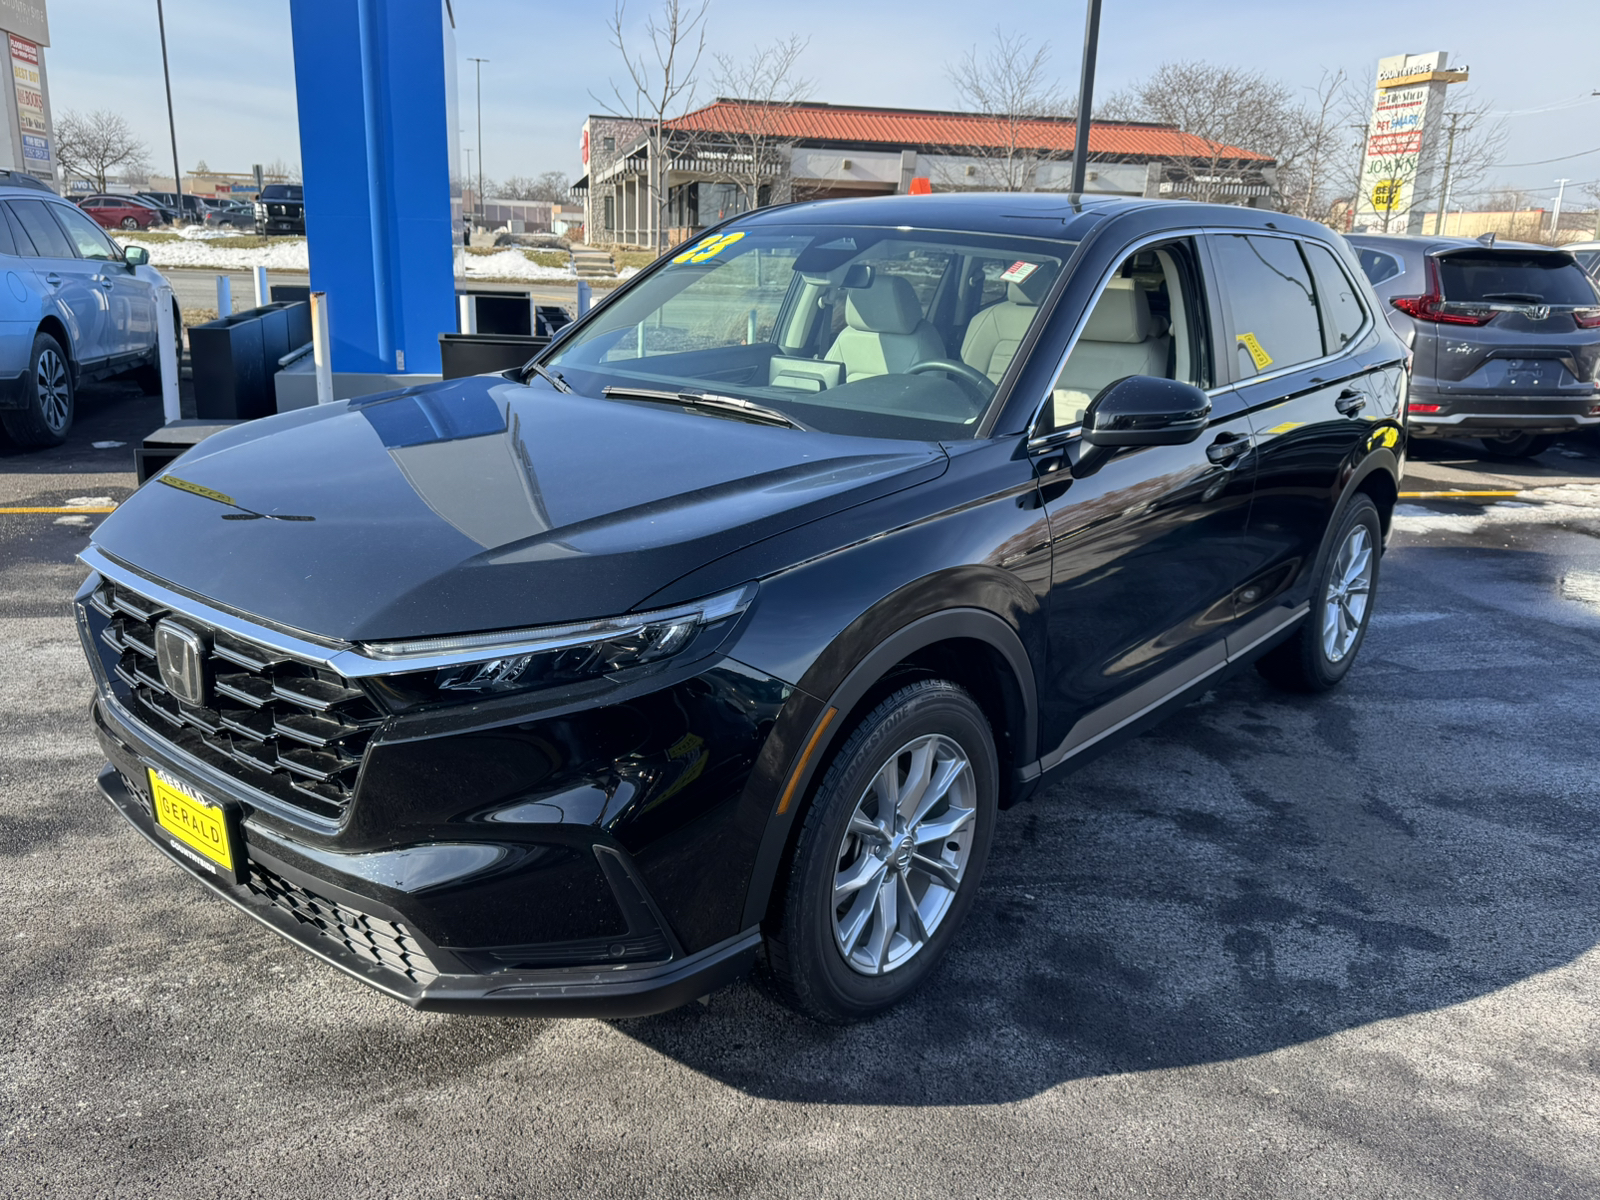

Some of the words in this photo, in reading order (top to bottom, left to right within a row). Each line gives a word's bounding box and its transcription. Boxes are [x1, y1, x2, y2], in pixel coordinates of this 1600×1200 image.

[697, 151, 728, 160] HONEY
[158, 770, 207, 807] GERALD
[162, 796, 220, 843] GERALD
